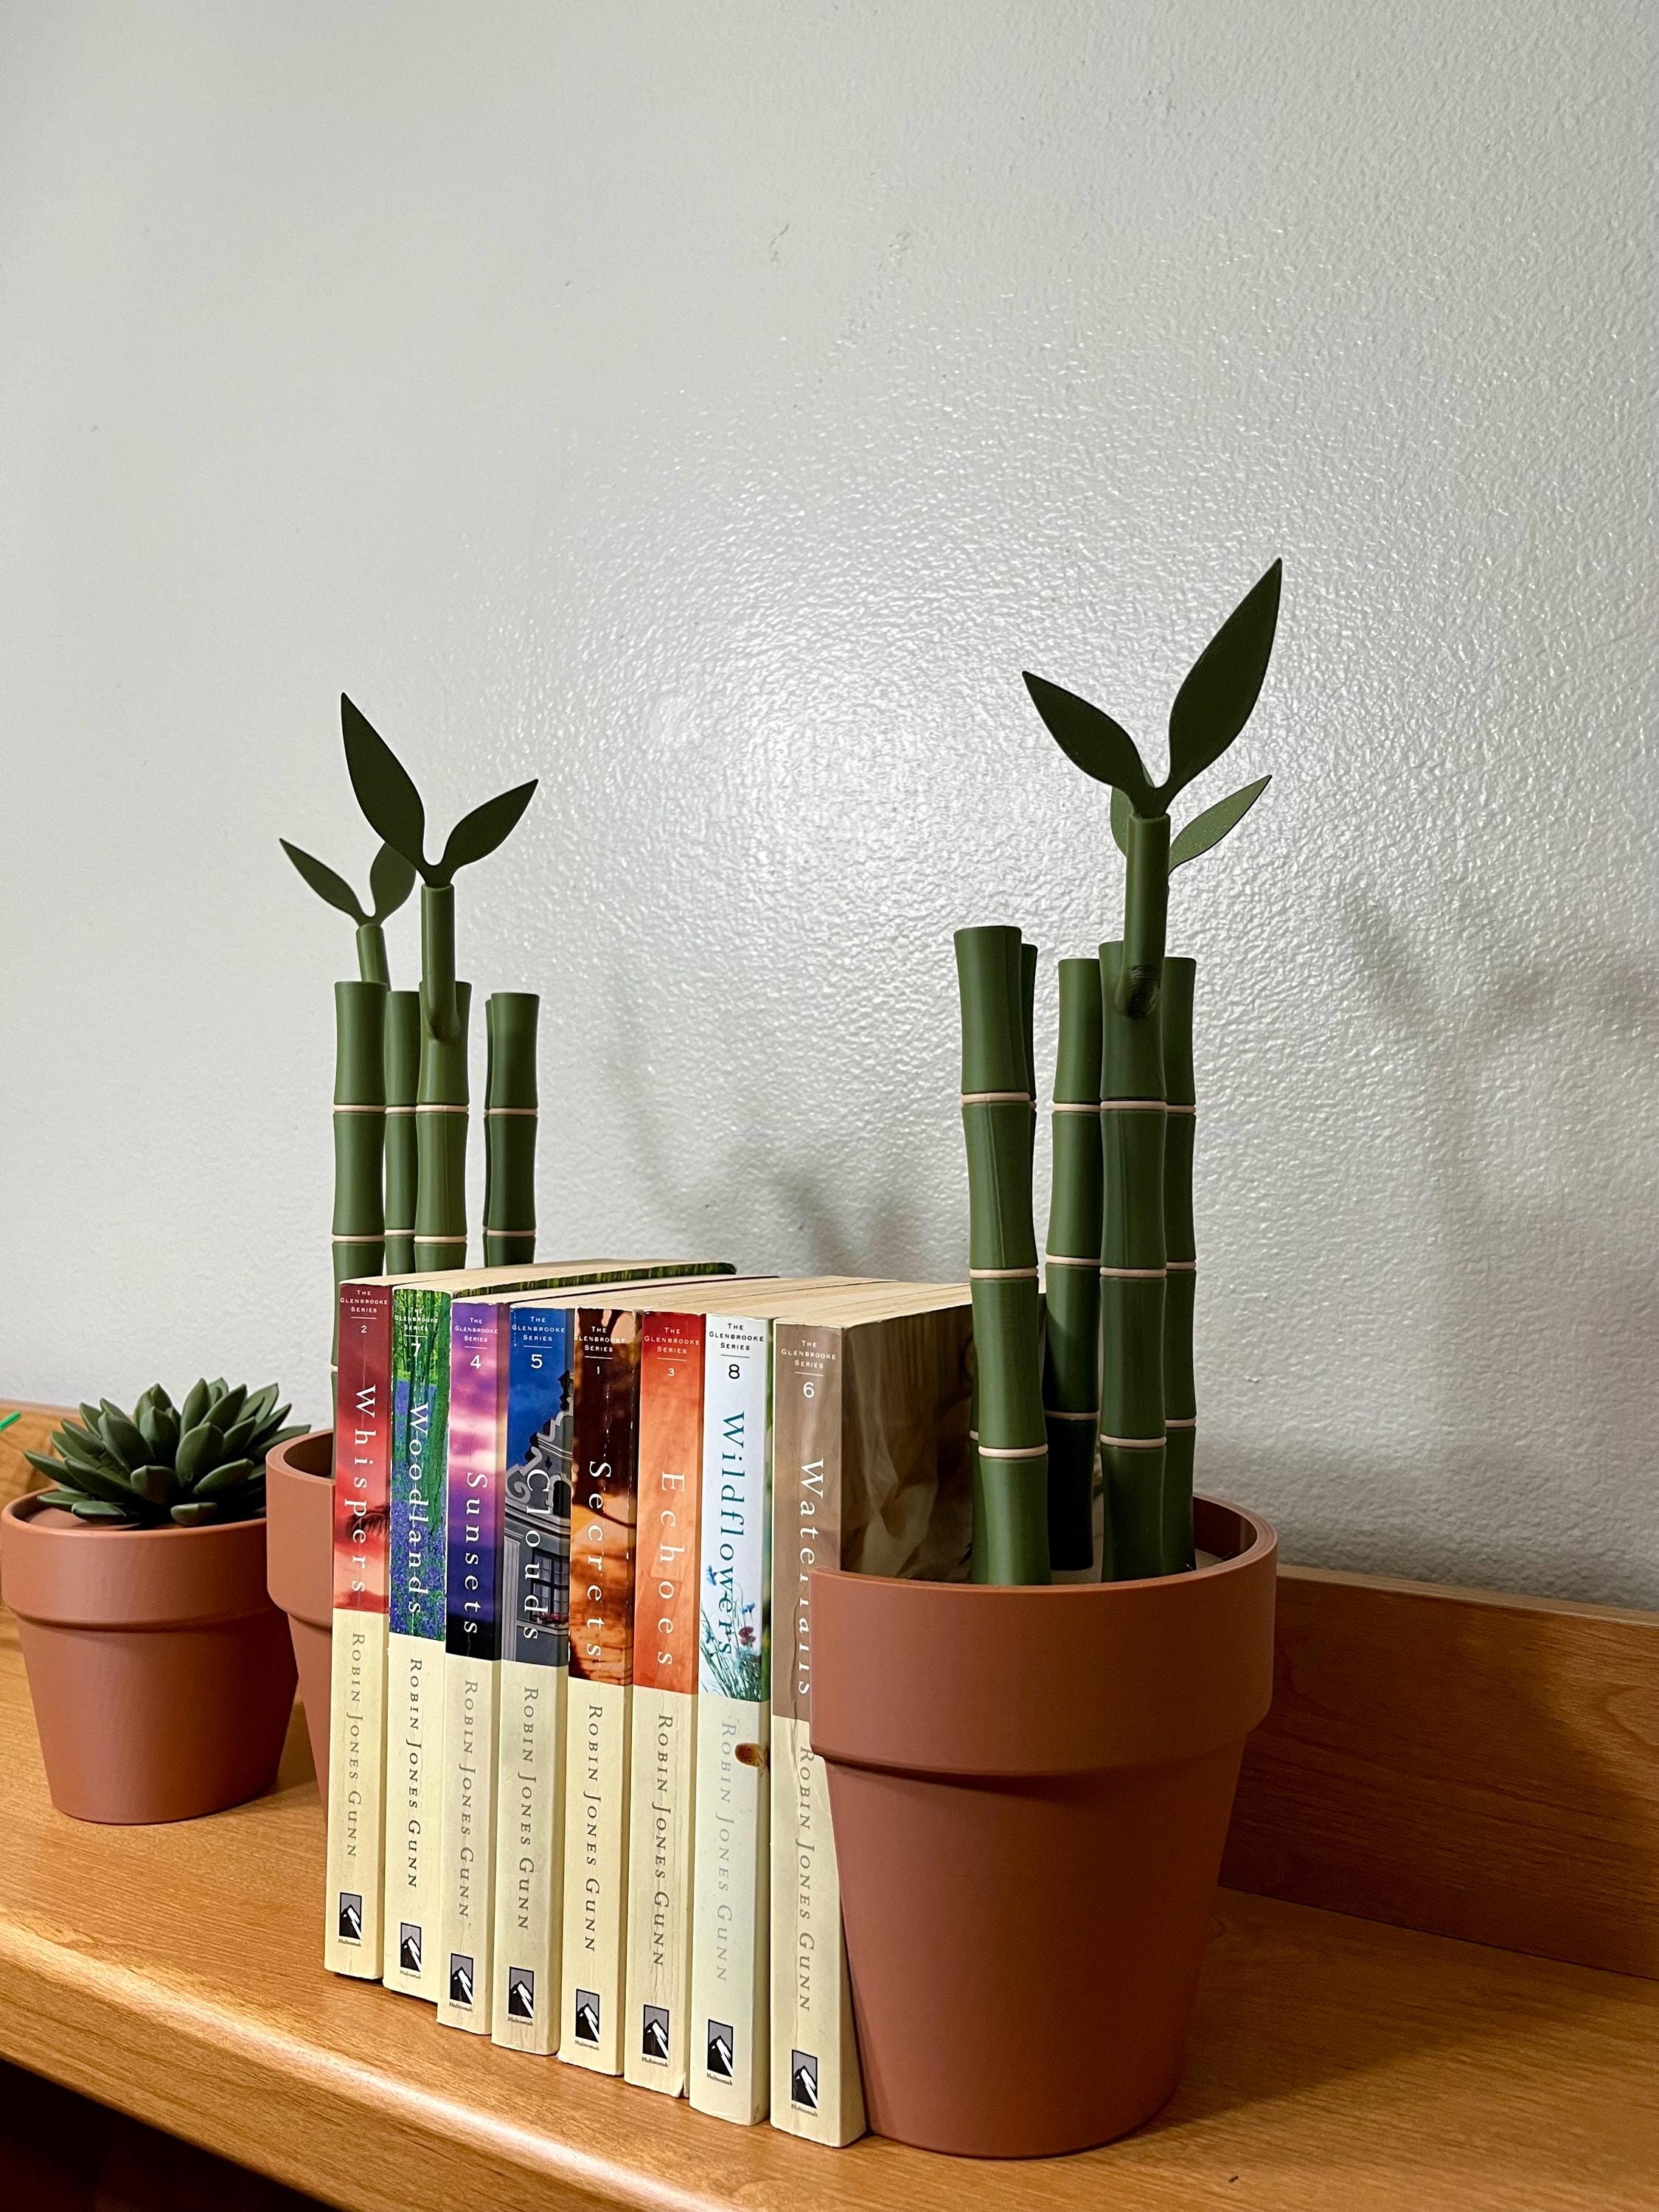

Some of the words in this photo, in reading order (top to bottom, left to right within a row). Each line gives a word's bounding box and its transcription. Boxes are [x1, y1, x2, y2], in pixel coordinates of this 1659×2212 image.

[361, 1325, 367, 1334] 2
[394, 1315, 439, 1324] GLENBROOKE
[411, 1343, 421, 1357] 7
[454, 1325, 498, 1334] GLENBROOKE
[512, 1324, 566, 1333] GLENBROOKE
[574, 1335, 626, 1344] GLENBROOKE
[584, 1344, 613, 1352] SERIES
[644, 1335, 700, 1346] GLENBROOKE
[657, 1346, 687, 1354] SERIES
[709, 1331, 764, 1342] GLENBROOKE
[720, 1343, 751, 1351] SERIES
[781, 1349, 837, 1360] GLENBROOKE
[801, 1340, 817, 1348] THE
[470, 1354, 481, 1369] 4
[531, 1354, 543, 1368] 5
[597, 1366, 600, 1374] 1
[668, 1367, 675, 1377] 3
[728, 1364, 740, 1379] 8
[794, 1359, 824, 1369] SERIES
[803, 1382, 815, 1398] 6
[344, 1384, 377, 1592] Whispers
[408, 1402, 430, 1613] Woodlands
[463, 1472, 489, 1633] Sunsets
[523, 1469, 551, 1639] Clouds
[586, 1461, 611, 1657] Secrets
[657, 1471, 685, 1665] Echoes
[718, 1411, 745, 1655] Wildflowers
[350, 1632, 365, 1703] ROBIN
[410, 1658, 422, 1730] ROBIN
[347, 1711, 364, 1779] JONES
[463, 1680, 478, 1754] ROBIN
[523, 1686, 539, 1763] ROBIN
[588, 1704, 603, 1782] ROBIN
[406, 1739, 422, 1808] JONES
[657, 1714, 673, 1792] ROBIN
[720, 1722, 737, 1803] ROBIN
[799, 1746, 815, 1829] ROBIN
[347, 1790, 361, 1857] GUNN
[459, 1764, 476, 1835] JONES
[518, 1772, 537, 1846] JONES
[583, 1790, 601, 1866] JONES
[408, 1820, 421, 1888] GUNN
[652, 1802, 671, 1879] JONES
[715, 1812, 734, 1892] JONES
[459, 1846, 474, 1917] GUNN
[518, 1857, 535, 1930] GUNN
[796, 1838, 815, 1919] JONES
[585, 1878, 600, 1952] GUNN
[653, 1891, 669, 1966] GUNN
[717, 1904, 732, 1982] GUNN
[799, 1932, 815, 2011] GUNN
